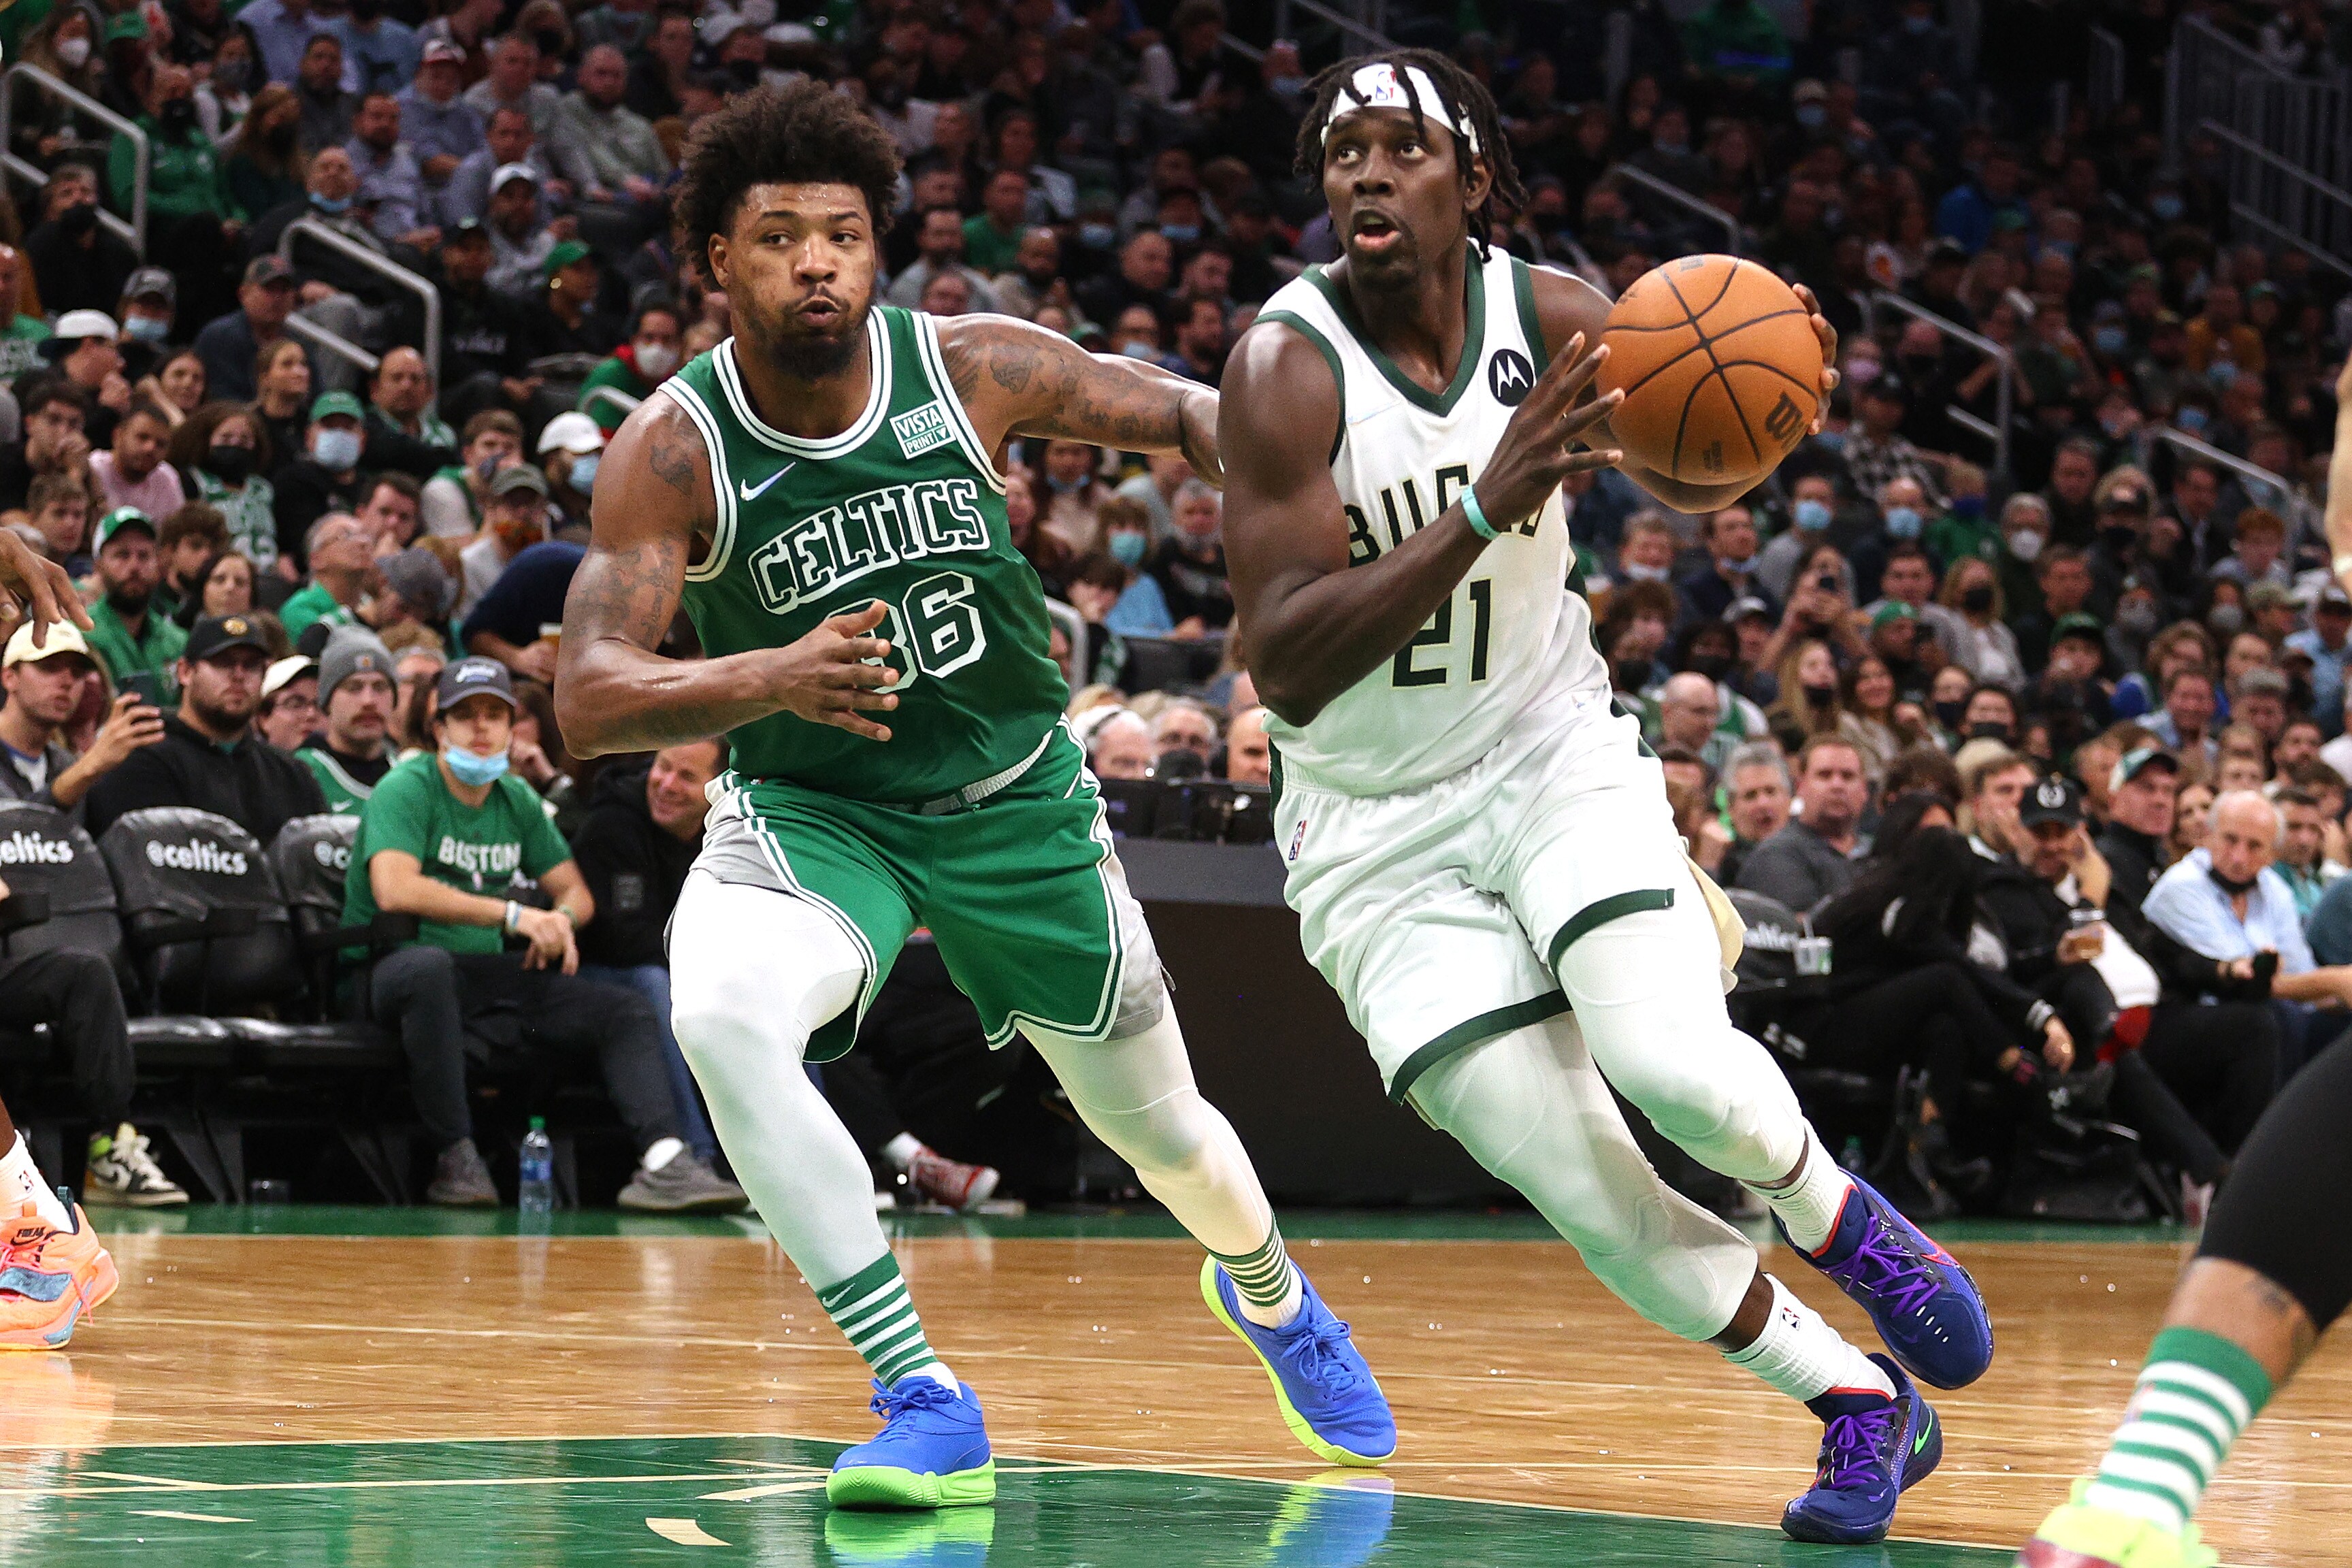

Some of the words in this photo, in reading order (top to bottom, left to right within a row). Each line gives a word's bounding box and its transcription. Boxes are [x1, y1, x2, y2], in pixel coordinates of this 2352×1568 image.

[896, 407, 944, 438] VISTA
[906, 433, 935, 453] PRINT
[1344, 463, 1546, 569] BUC
[748, 478, 990, 615] CELTICS
[1391, 577, 1494, 689] 21
[0, 830, 74, 864] eltics
[146, 838, 248, 875] @celtics
